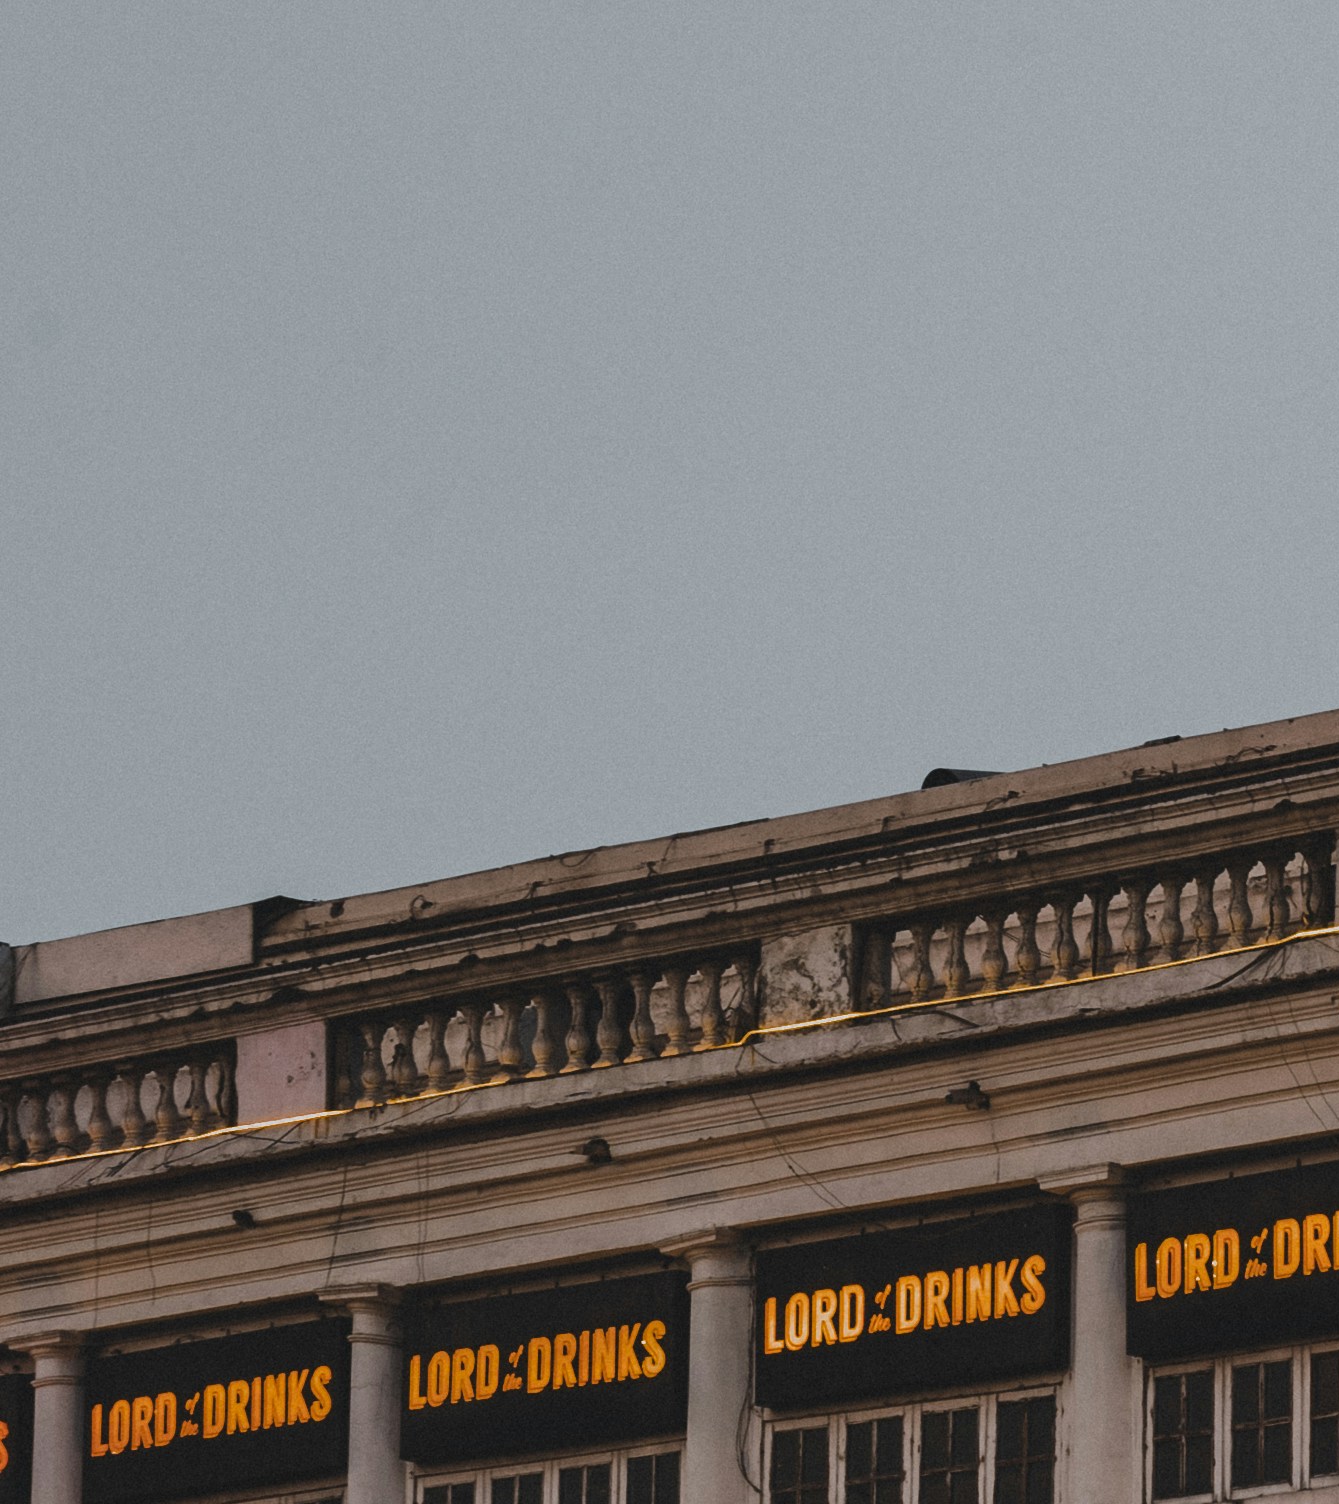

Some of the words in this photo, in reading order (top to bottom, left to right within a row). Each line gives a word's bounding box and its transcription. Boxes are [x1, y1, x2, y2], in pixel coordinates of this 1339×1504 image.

[1249, 1228, 1269, 1255] of
[1134, 1227, 1241, 1303] LORD
[1243, 1257, 1269, 1281] the
[874, 1284, 893, 1310] of
[895, 1253, 1047, 1336] DRINKS
[764, 1283, 867, 1356] LORD
[867, 1313, 892, 1335] the
[508, 1344, 525, 1369] of
[527, 1318, 668, 1395] DRINKS
[408, 1344, 501, 1411] LORD
[501, 1371, 524, 1393] the
[184, 1392, 201, 1416] of
[203, 1364, 334, 1440] DRINKS
[91, 1391, 178, 1458] LORD
[178, 1419, 200, 1439] the
